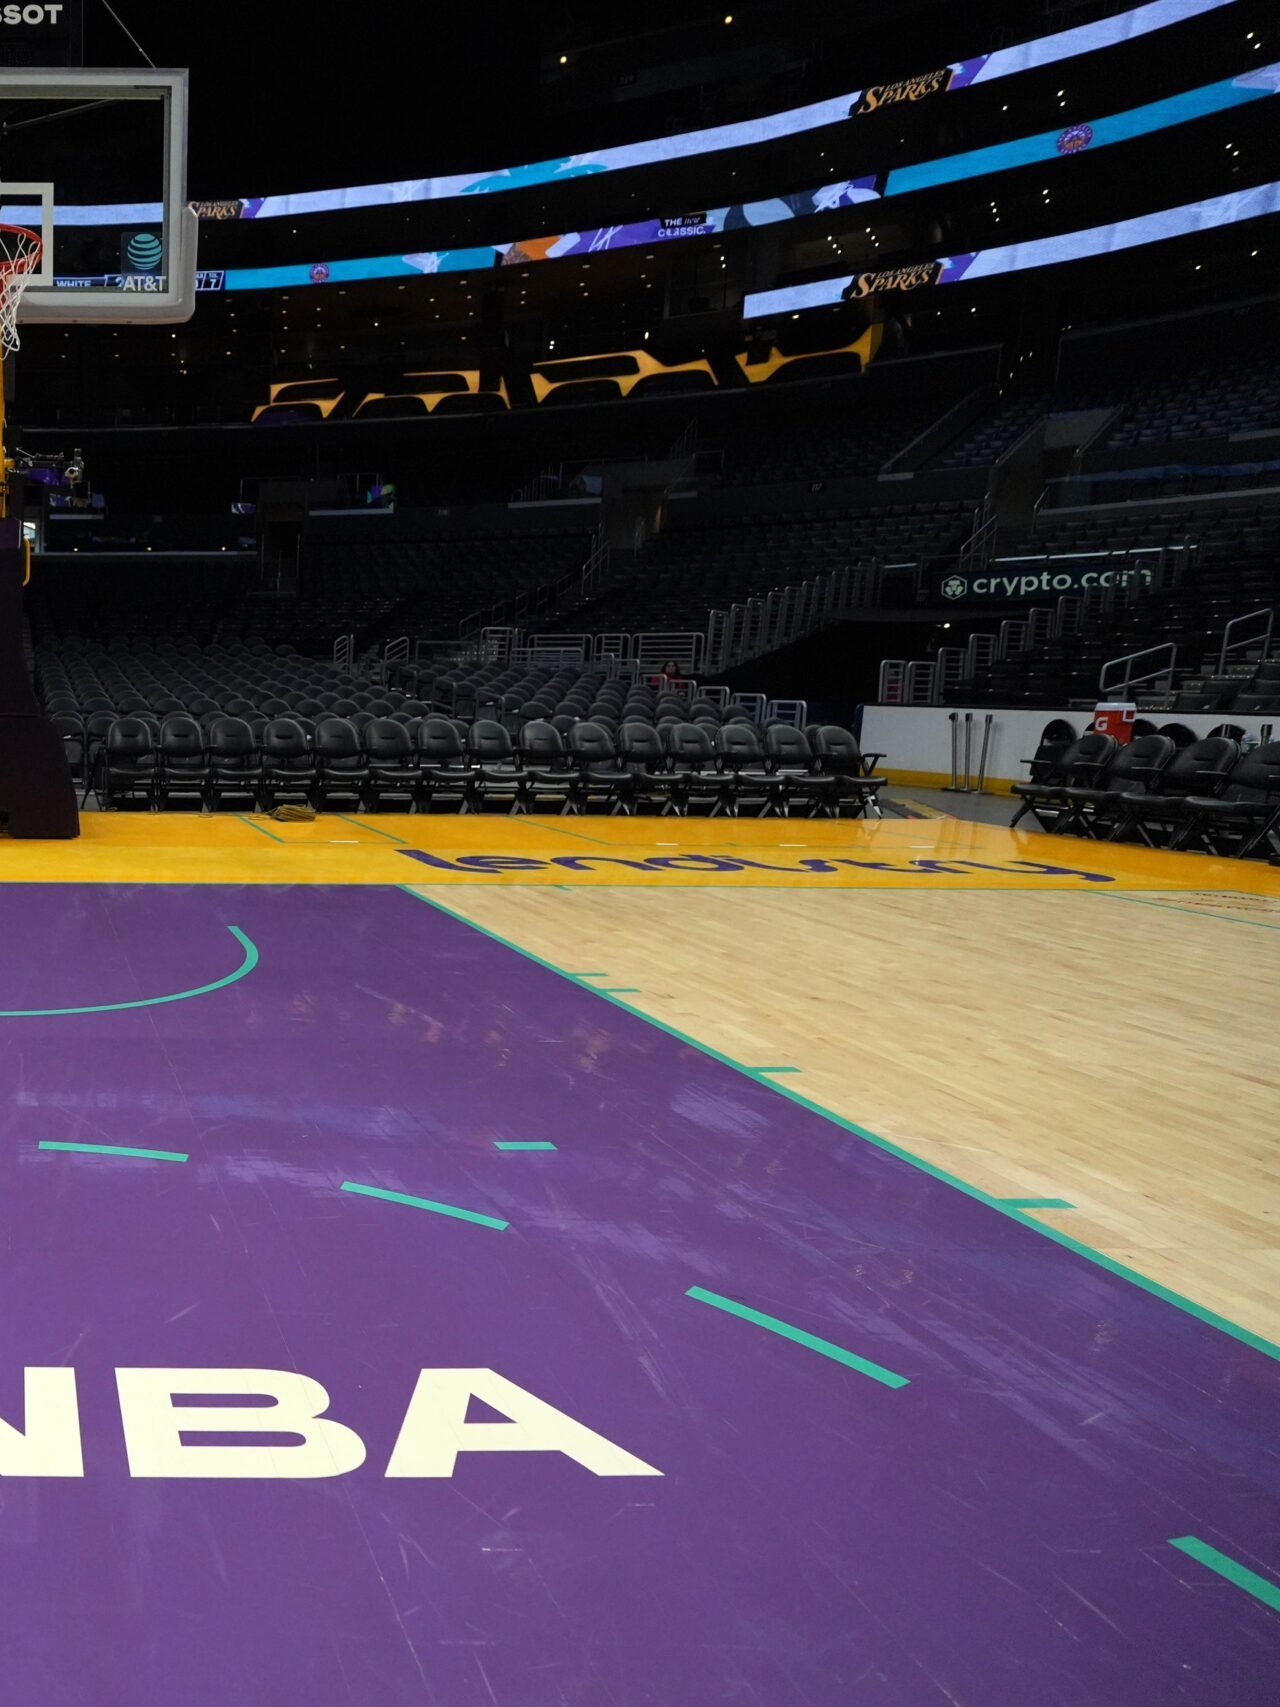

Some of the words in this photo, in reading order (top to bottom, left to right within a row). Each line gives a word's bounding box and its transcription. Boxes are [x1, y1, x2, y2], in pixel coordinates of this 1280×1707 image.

[857, 77, 943, 114] SPARKS
[664, 218, 682, 227] THE
[56, 280, 91, 288] WHITE
[123, 276, 167, 292] AT&T
[210, 279, 217, 288] 7
[850, 269, 933, 298] SPARKS
[394, 849, 1116, 883] lendistry
